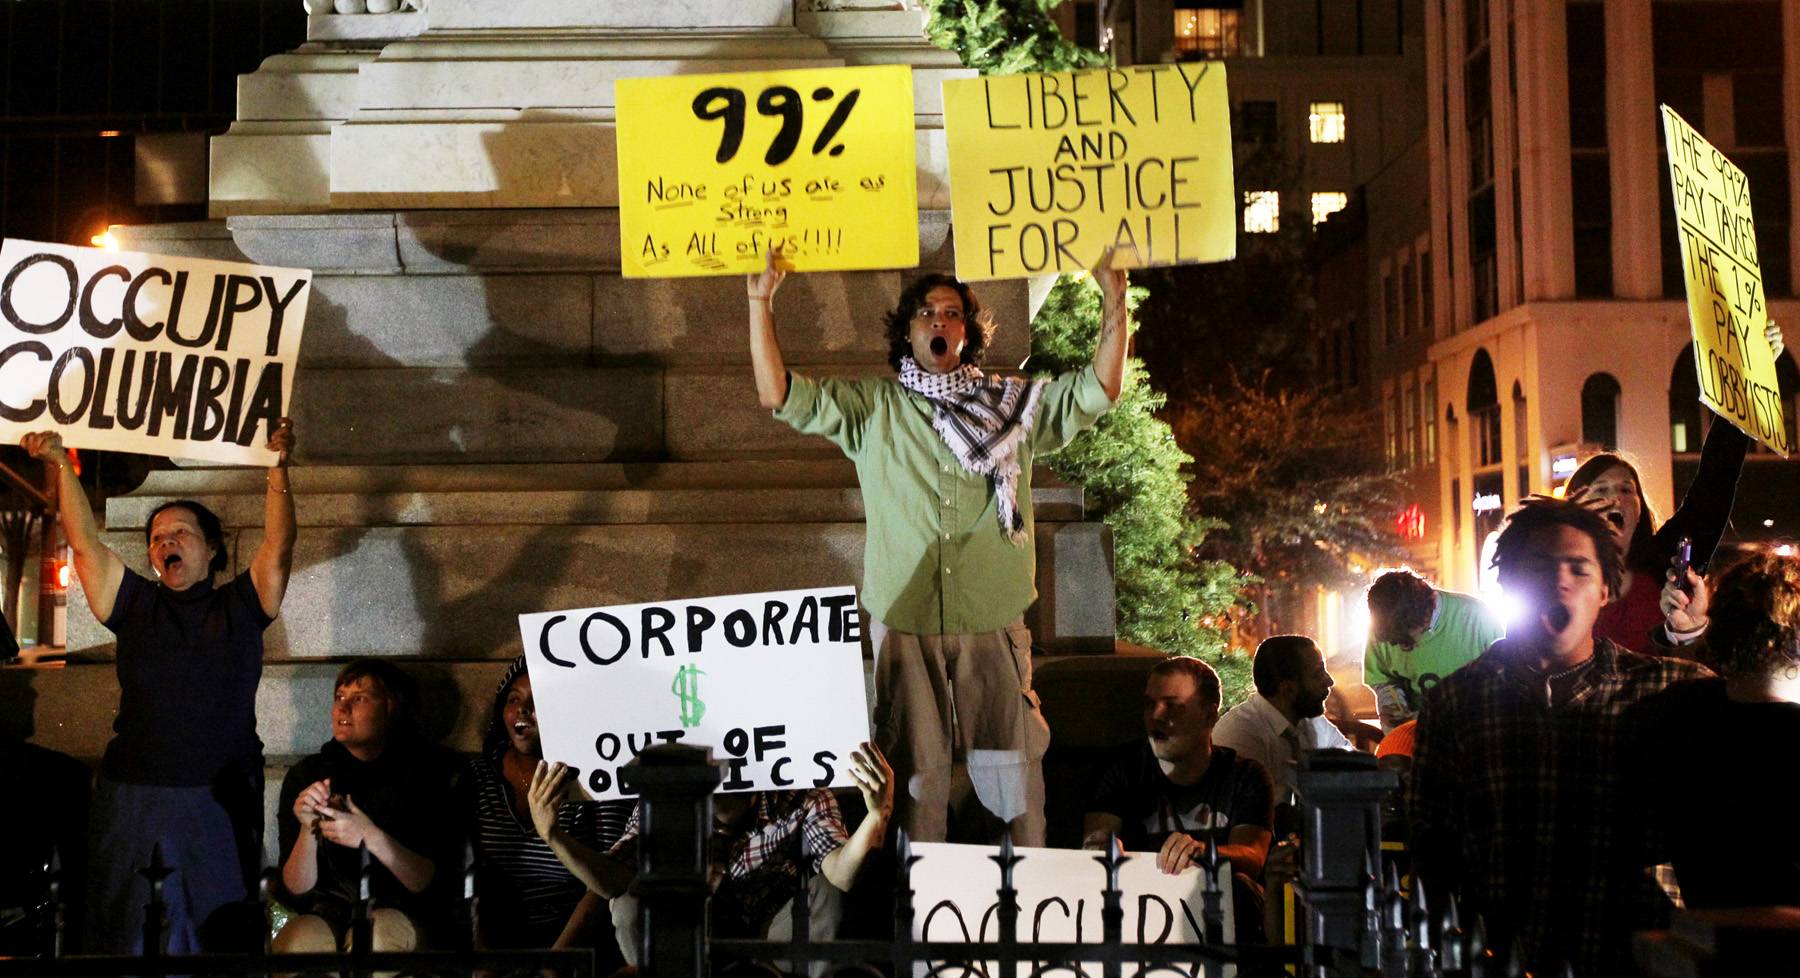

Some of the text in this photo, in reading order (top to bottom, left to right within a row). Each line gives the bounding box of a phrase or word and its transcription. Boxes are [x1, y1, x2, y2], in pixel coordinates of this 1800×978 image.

[692, 86, 860, 166] 99%
[985, 62, 1208, 130] LIBERTY
[1054, 131, 1128, 162] AND
[1666, 109, 1750, 207] THE 99%
[647, 177, 708, 204] None
[724, 174, 755, 199] of
[806, 176, 841, 192] are
[860, 175, 885, 190] as
[987, 156, 1202, 216] JUSTICE
[1673, 163, 1760, 268] PAY TAXES
[736, 230, 763, 255] of
[988, 213, 1199, 276] FOR ALL
[1682, 226, 1761, 319] THE 1%
[1, 253, 307, 356] OCCUPY
[1713, 300, 1751, 370] PAY
[0, 341, 283, 447] COLUMBIA
[1696, 340, 1788, 450] LOBBYISTS
[540, 594, 861, 669] CORPORATE
[671, 663, 706, 728] $
[565, 751, 837, 795] OLICS
[723, 725, 786, 762] OF
